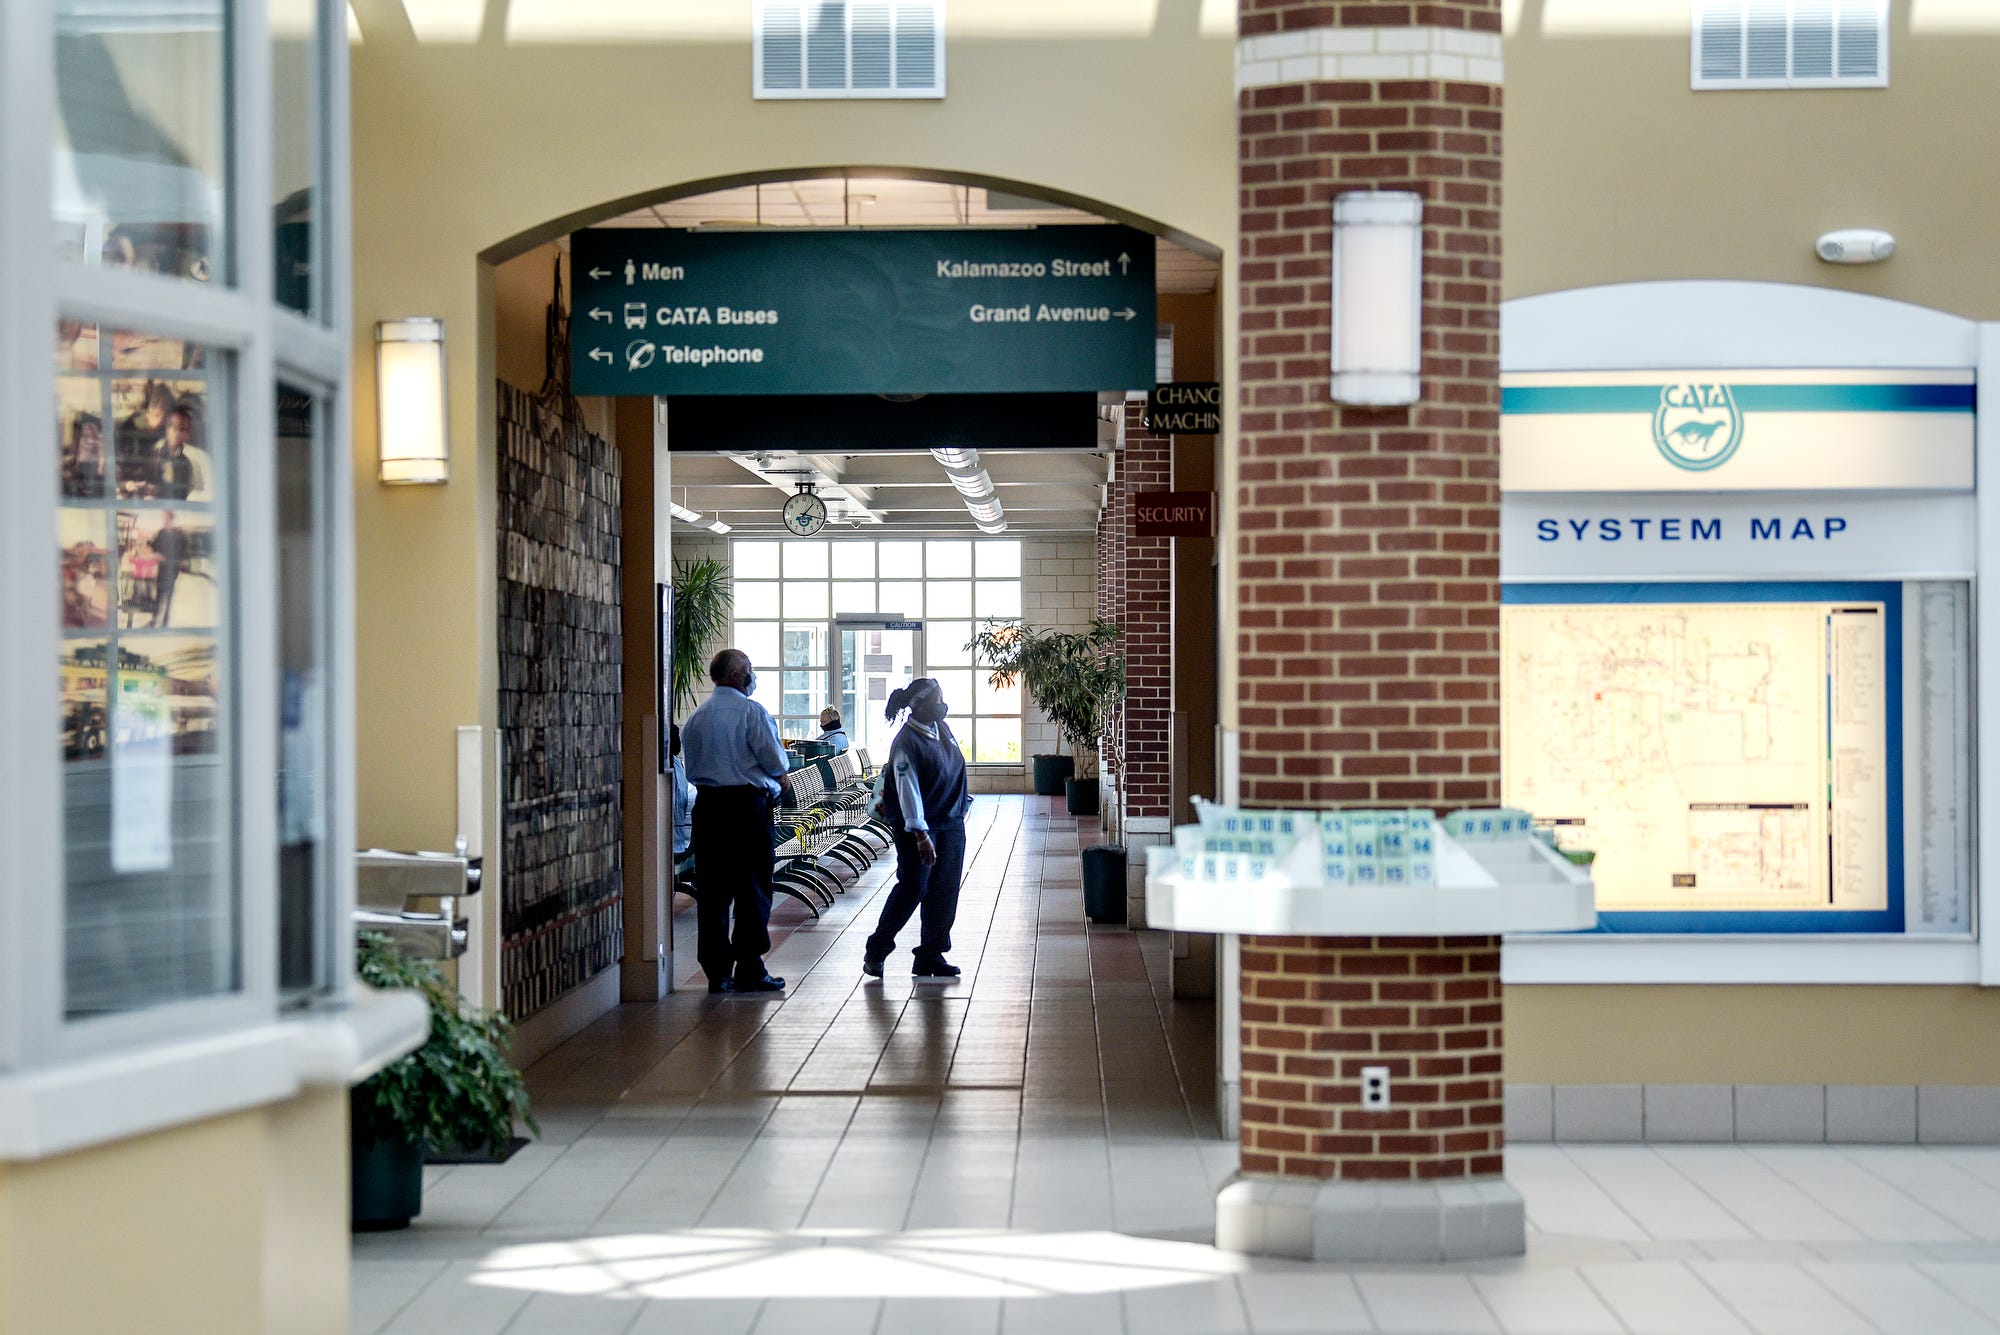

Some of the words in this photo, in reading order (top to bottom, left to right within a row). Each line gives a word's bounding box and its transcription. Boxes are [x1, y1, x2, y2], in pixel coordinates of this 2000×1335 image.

[642, 263, 684, 280] Men
[936, 259, 1046, 278] Kalamazoo
[1051, 259, 1111, 277] Street
[656, 307, 711, 325] CATA
[716, 307, 778, 325] Buses
[969, 304, 1031, 323] Grand
[1036, 304, 1110, 322] Avenue
[662, 345, 764, 367] Telephone
[1664, 384, 1731, 412] CATA
[1137, 507, 1207, 523] SECURITY
[1537, 518, 1722, 541] SYSTEM
[1750, 517, 1848, 540] MAP
